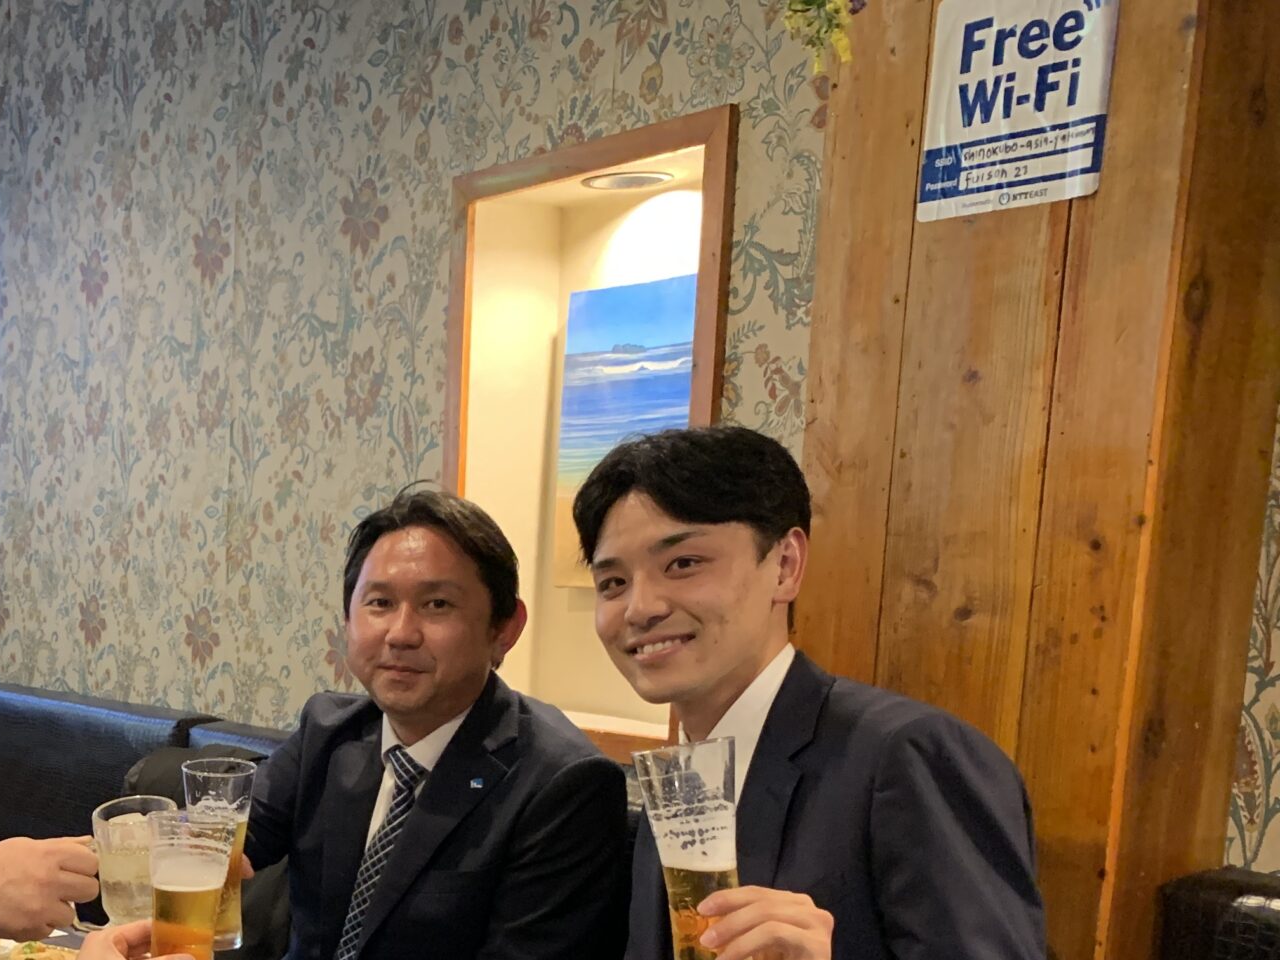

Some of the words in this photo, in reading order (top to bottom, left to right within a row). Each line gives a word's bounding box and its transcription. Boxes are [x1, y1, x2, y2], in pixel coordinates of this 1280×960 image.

[960, 10, 1085, 74] Free
[958, 58, 1081, 128] Wi-Fi
[934, 156, 953, 168] SSID
